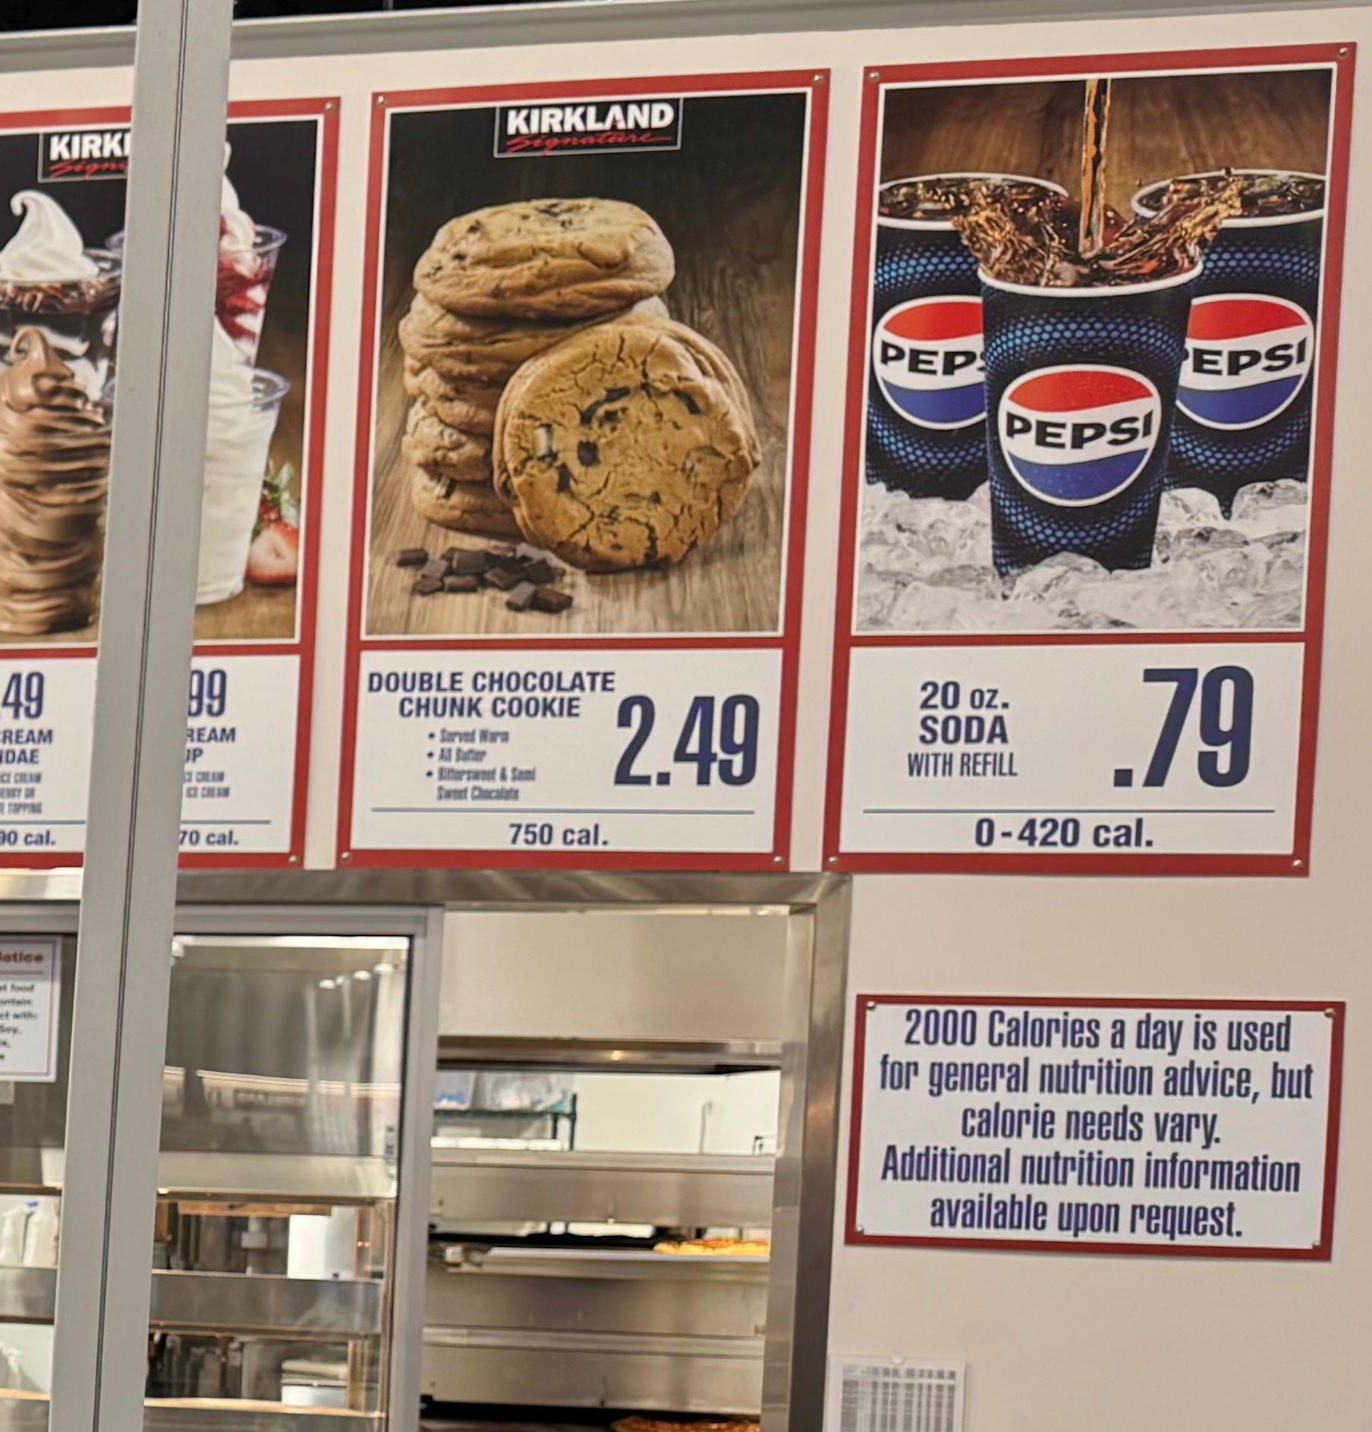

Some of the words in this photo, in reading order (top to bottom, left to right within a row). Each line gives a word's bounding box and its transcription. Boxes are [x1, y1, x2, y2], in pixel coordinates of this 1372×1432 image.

[507, 102, 673, 132] KIRKLAND
[50, 132, 130, 160] KIRK
[507, 129, 670, 154] Signature
[880, 341, 985, 375] PEP
[1181, 337, 1305, 375] EPSI
[1006, 410, 1153, 449] PEPSI
[188, 669, 226, 717] 99
[368, 672, 464, 692] DOUBLE
[472, 672, 615, 692] CHOCOLATE
[920, 681, 959, 710] 20
[970, 687, 1009, 710] oz.
[399, 697, 482, 718] CHUNK
[491, 697, 581, 718] COOKIE
[187, 727, 236, 743] REAM
[614, 695, 760, 787] 2.49
[919, 715, 1008, 745] SODA
[1114, 665, 1254, 788] .79
[907, 752, 953, 777] WITH
[959, 753, 1018, 777] REFILL
[24, 830, 56, 847] cal.
[180, 831, 200, 845] 70
[206, 831, 238, 845] cal.
[509, 823, 553, 846] 750
[562, 823, 608, 846] cal.
[1092, 818, 1153, 847] cal.
[904, 1009, 977, 1046] 2000
[988, 1011, 1100, 1049] Calories
[1111, 1017, 1125, 1049] a
[1135, 1012, 1183, 1055] day
[1193, 1014, 1217, 1052] is
[1227, 1015, 1291, 1052] used
[880, 1054, 919, 1091] for
[928, 1057, 1029, 1097] general
[1039, 1058, 1153, 1096] nutrition
[1163, 1061, 1259, 1104] advice,
[1271, 1062, 1313, 1100] but
[961, 1101, 1055, 1139] calorie
[1065, 1104, 1143, 1142] needs
[1155, 1111, 1222, 1149] vary.
[881, 1144, 1010, 1185] Additional
[1020, 1150, 1134, 1188] nutrition
[1144, 1152, 1301, 1192] information
[930, 1193, 1047, 1231] available
[1058, 1200, 1120, 1238] upon
[1130, 1201, 1243, 1240] request.
